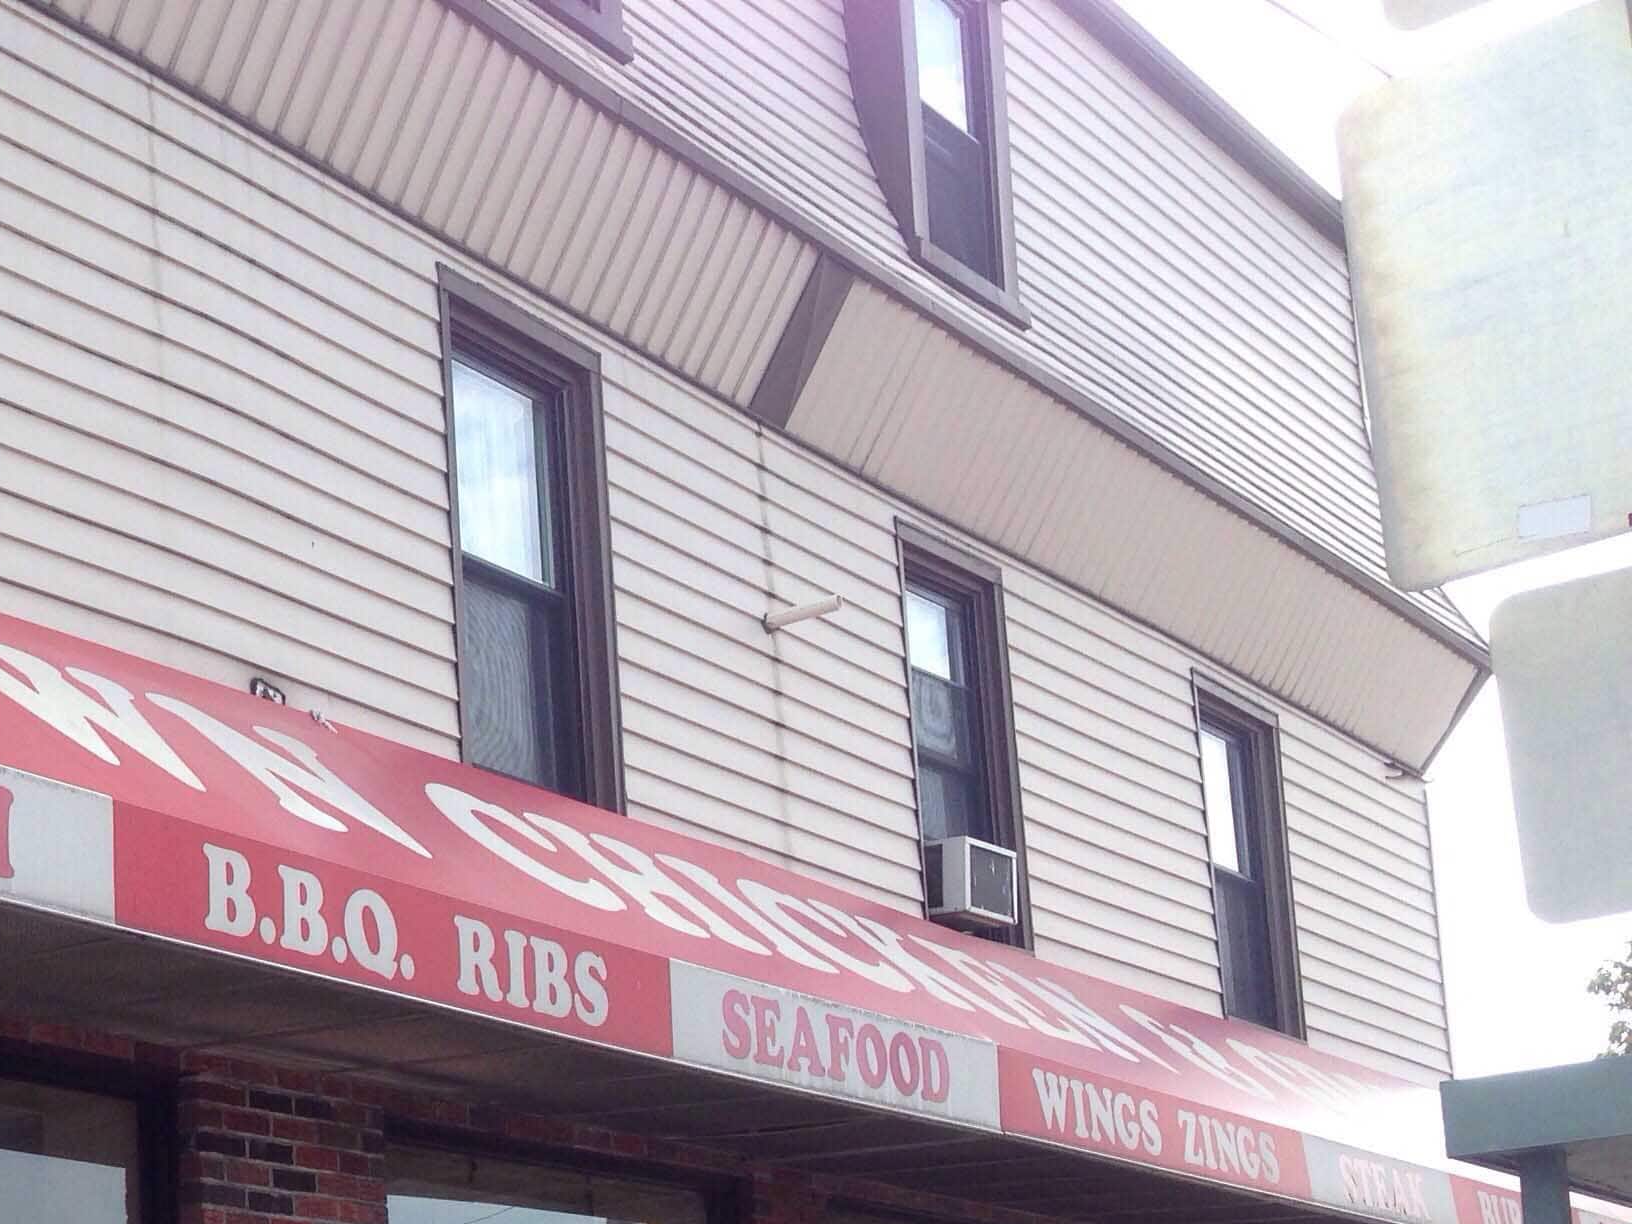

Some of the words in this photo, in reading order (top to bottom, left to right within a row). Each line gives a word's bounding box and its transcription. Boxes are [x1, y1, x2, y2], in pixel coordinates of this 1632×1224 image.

[202, 843, 415, 981] B.B.Q.
[453, 915, 609, 1027] RIBS
[424, 782, 1182, 1076] CHICKEN
[721, 989, 950, 1103] SEAFOOD
[1031, 1067, 1163, 1156] WINGS
[1177, 1109, 1280, 1184] ZINGS
[1339, 1154, 1432, 1221] STEAK
